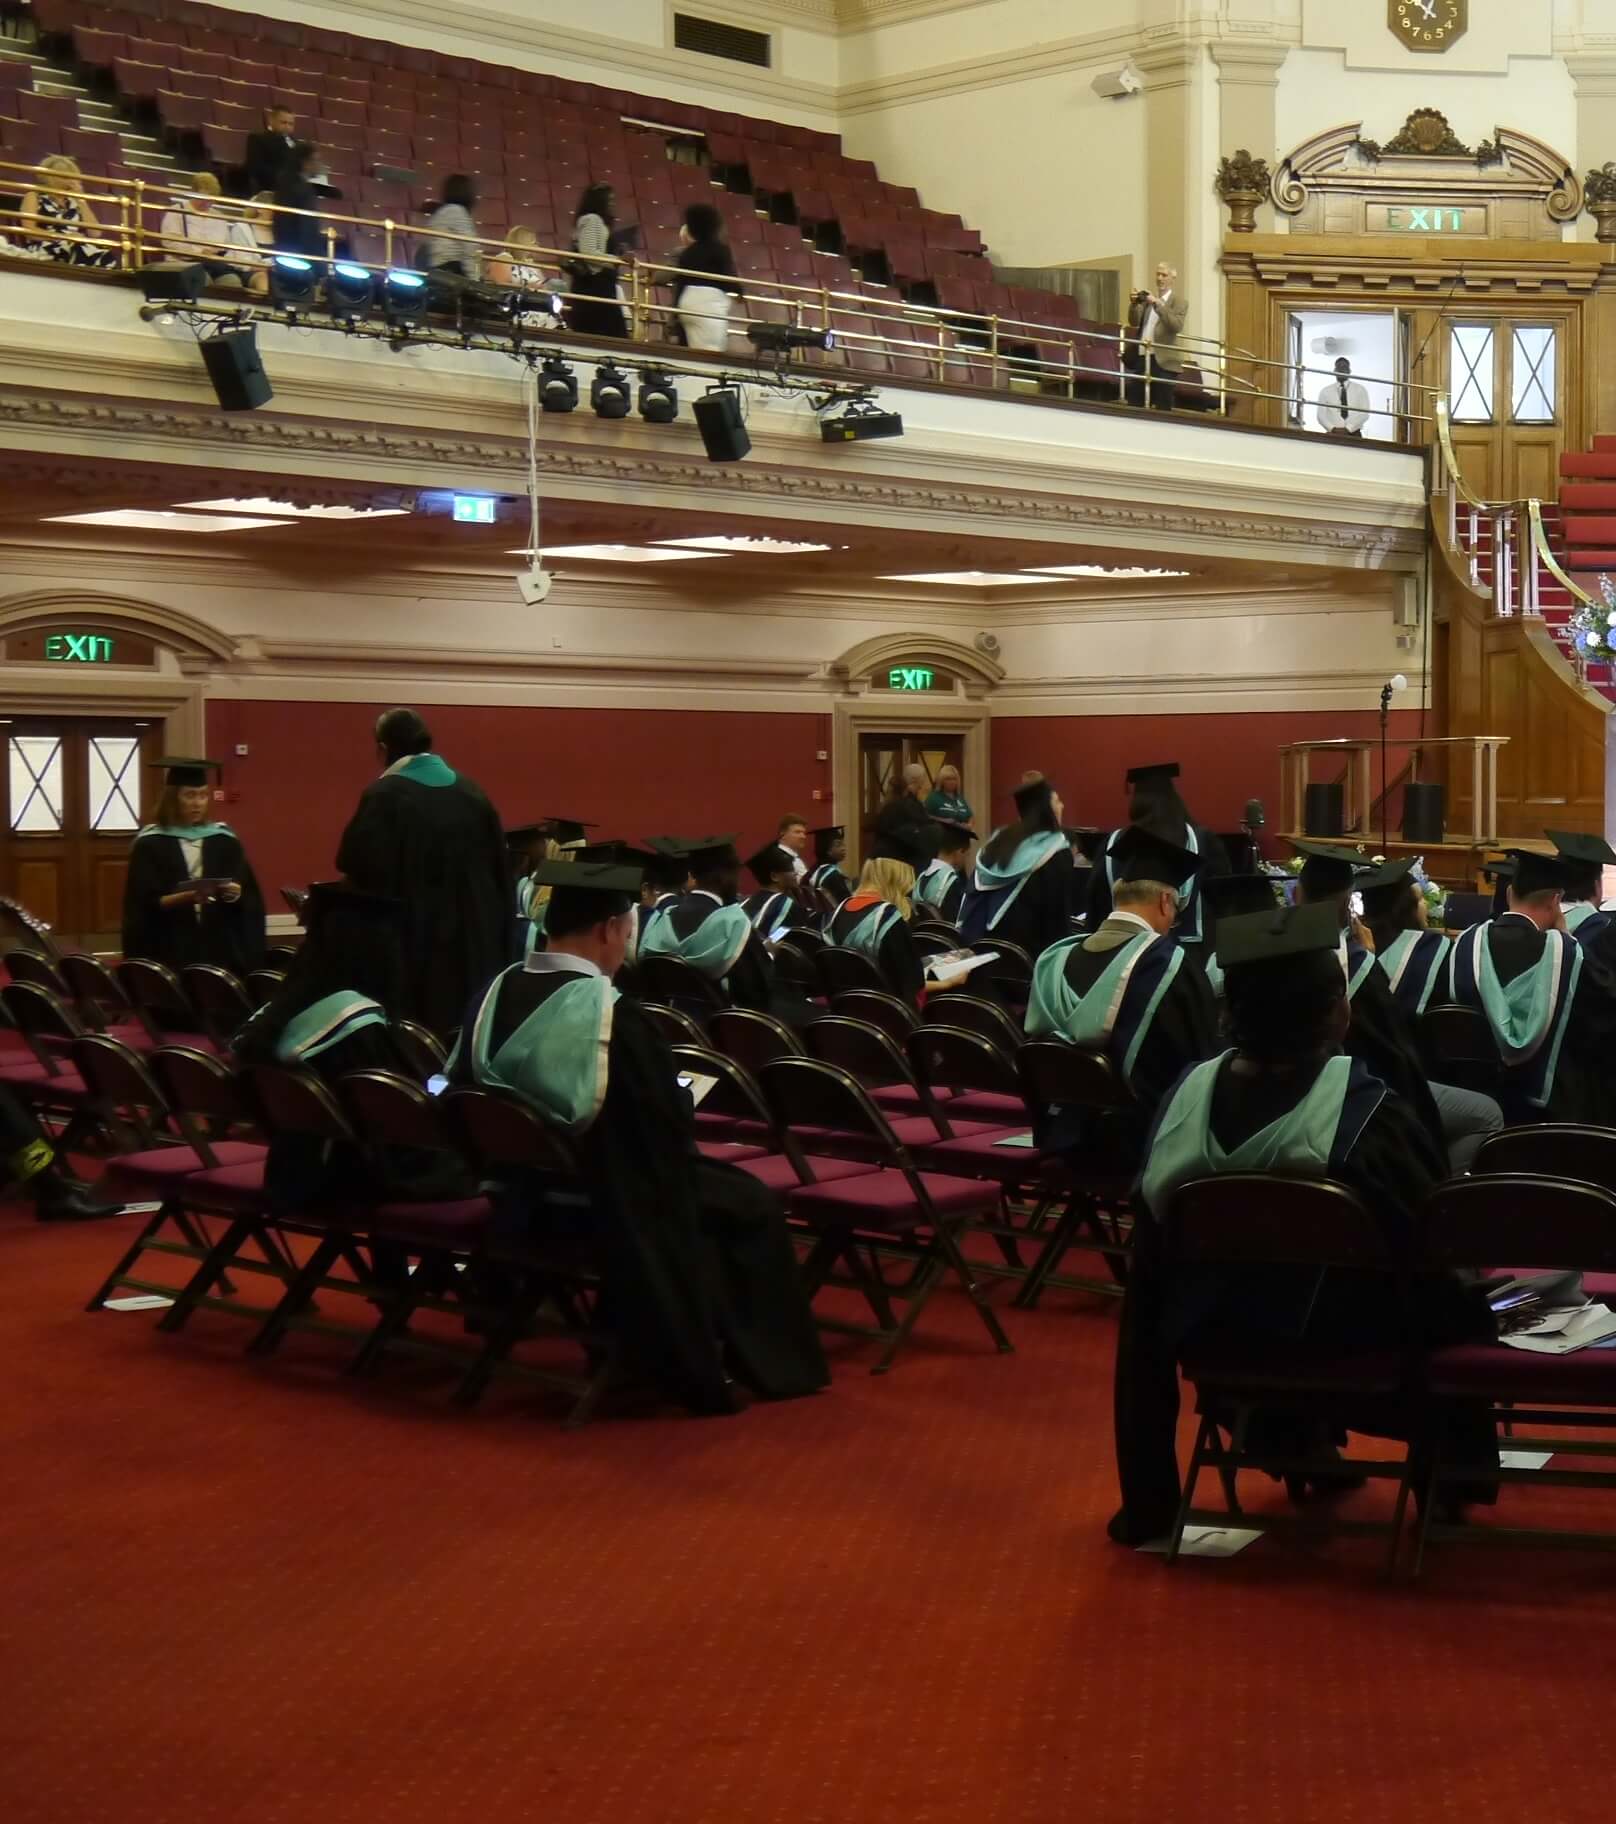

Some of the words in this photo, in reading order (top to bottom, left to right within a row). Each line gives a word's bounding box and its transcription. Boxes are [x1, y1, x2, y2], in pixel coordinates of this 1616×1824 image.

[1397, 5, 1406, 16] 9
[1449, 7, 1458, 17] 3
[1402, 17, 1411, 28] 8
[1443, 20, 1454, 29] 4
[1412, 27, 1421, 37] 7
[1423, 31, 1432, 40] 6
[1435, 28, 1444, 38] 5
[1387, 208, 1466, 231] EXIT
[46, 634, 115, 662] EXIT
[889, 668, 934, 690] EXIT
